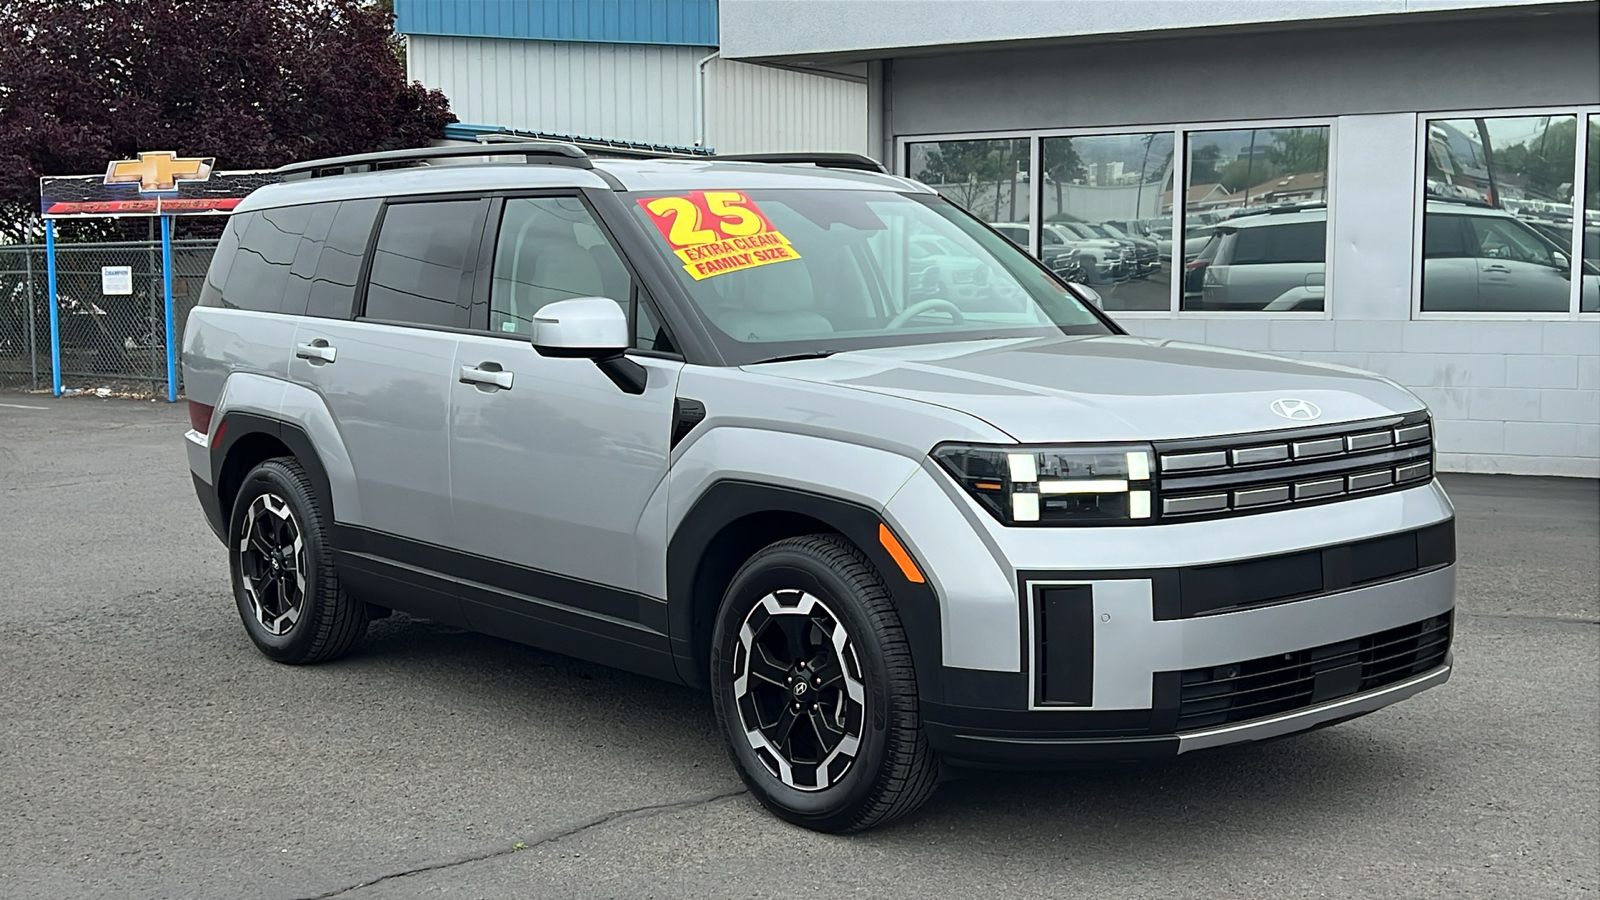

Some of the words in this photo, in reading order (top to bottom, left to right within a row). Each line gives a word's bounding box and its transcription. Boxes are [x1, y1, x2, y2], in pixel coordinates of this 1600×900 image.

[647, 192, 766, 246] 25
[684, 241, 735, 262] EXTRA
[733, 233, 782, 251] CLEAN
[695, 253, 752, 276] FAMILY
[753, 247, 793, 262] SIZE
